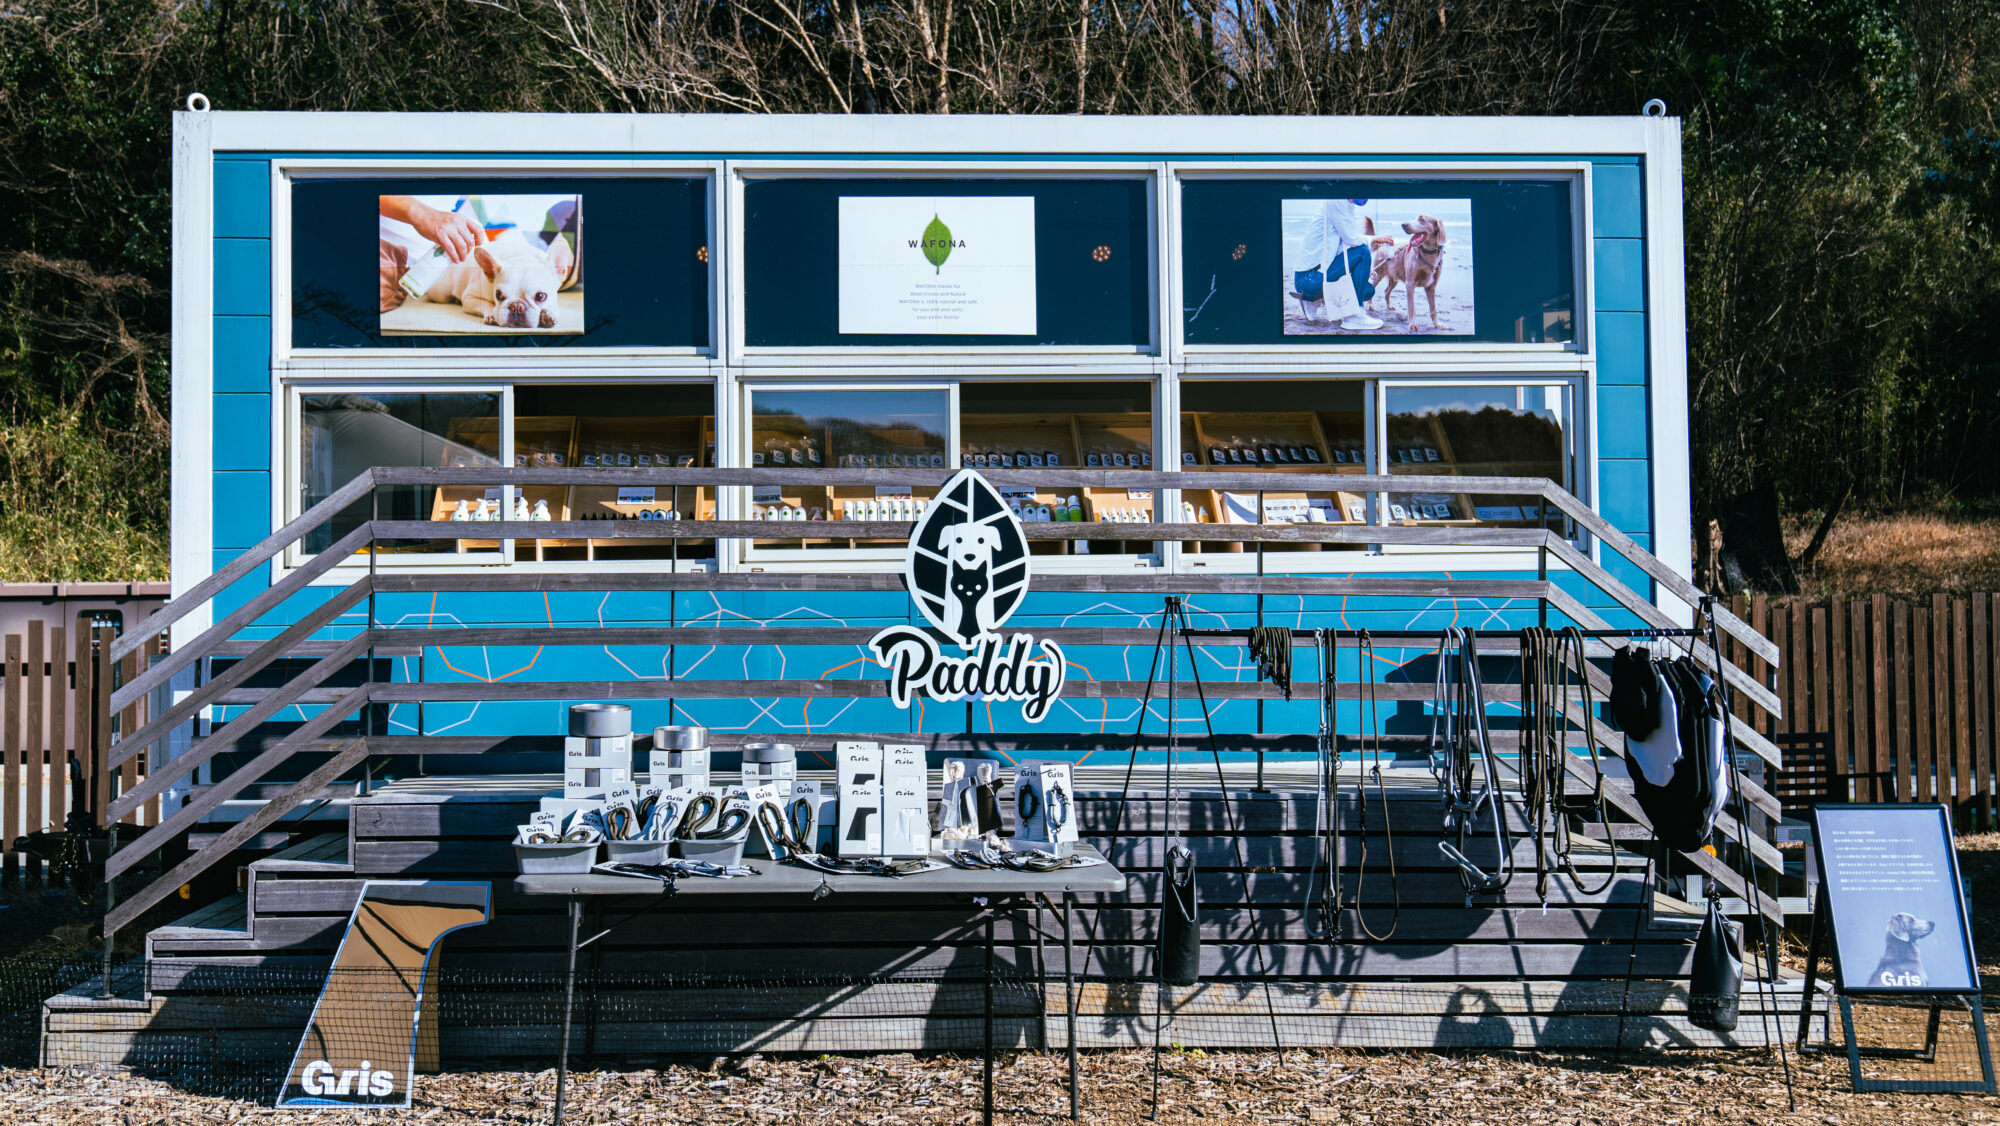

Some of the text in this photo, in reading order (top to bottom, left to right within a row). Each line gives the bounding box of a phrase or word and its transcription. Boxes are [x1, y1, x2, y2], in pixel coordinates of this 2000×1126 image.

[908, 240, 966, 248] WAFONA
[873, 630, 1063, 721] Paddy
[612, 789, 630, 798] Gris
[756, 791, 772, 799] Gris
[607, 802, 624, 810] Gris
[1881, 971, 1922, 986] Gris
[302, 1060, 394, 1096] Gris
